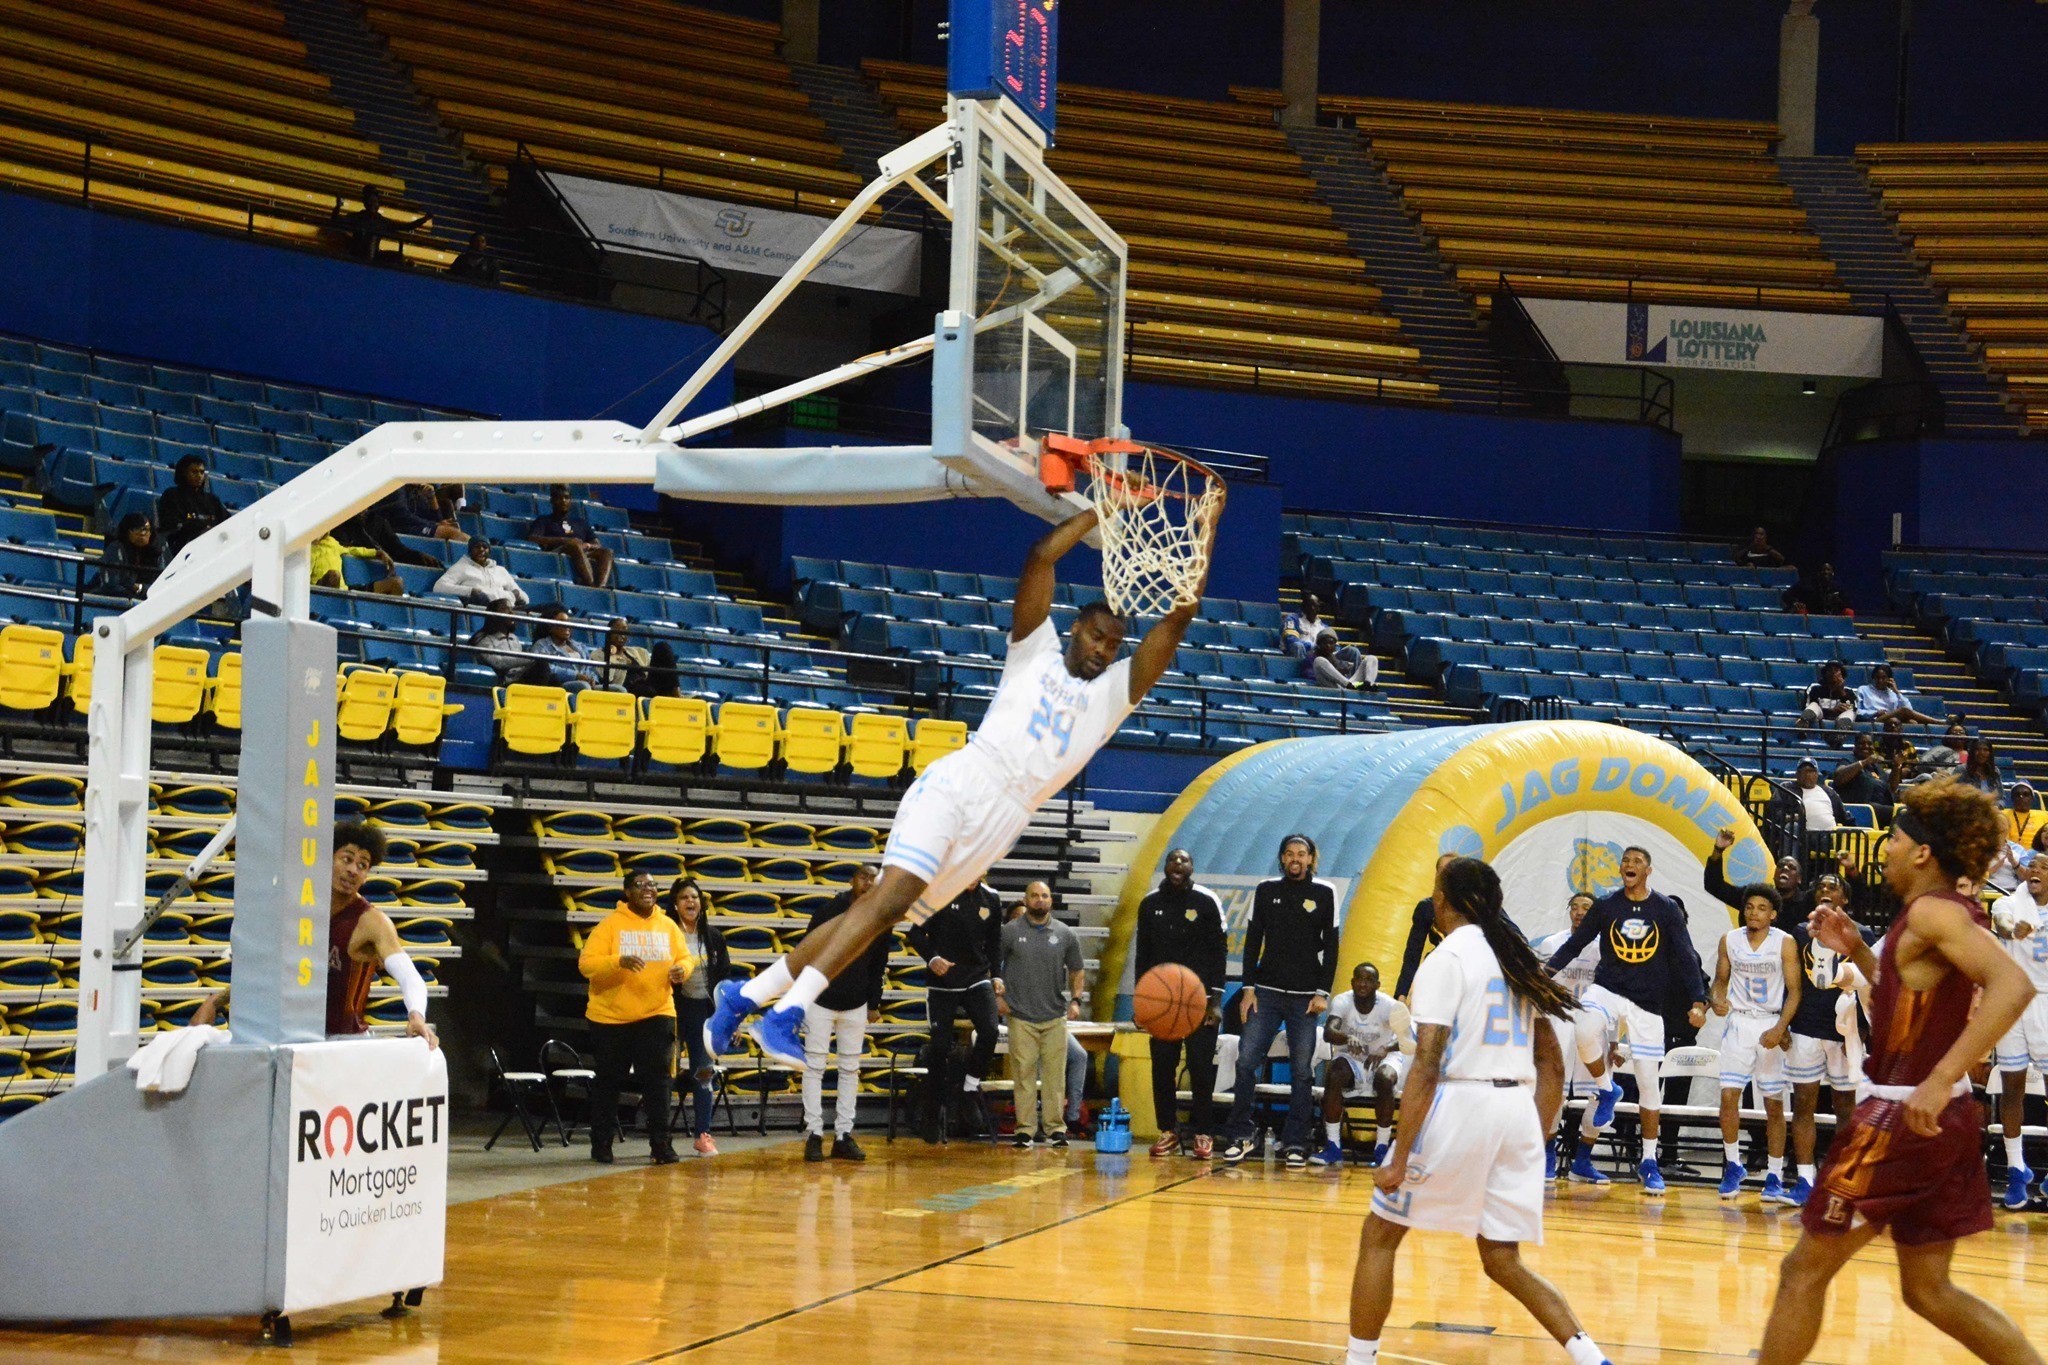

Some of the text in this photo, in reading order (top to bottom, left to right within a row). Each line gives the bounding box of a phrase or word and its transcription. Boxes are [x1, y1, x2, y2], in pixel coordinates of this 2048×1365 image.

[607, 224, 656, 241] Southern
[659, 232, 709, 249] University
[713, 243, 731, 252] and
[734, 245, 761, 257] A&M
[1670, 319, 1767, 343] LOUISIANA
[1677, 339, 1760, 361] LOTTERY
[1677, 359, 1756, 369] CORPORATION
[1495, 757, 1736, 839] JAG DOME
[297, 719, 321, 986] JAGUARS
[620, 931, 669, 946] SOUTHERN
[1620, 918, 1651, 940] SU
[1733, 960, 1777, 975] SOUTHERN
[1744, 977, 1769, 1003] 13
[297, 1095, 446, 1163] ROCKET
[329, 1164, 418, 1199] Mortgage
[320, 1201, 422, 1237] by Quicken Loans
